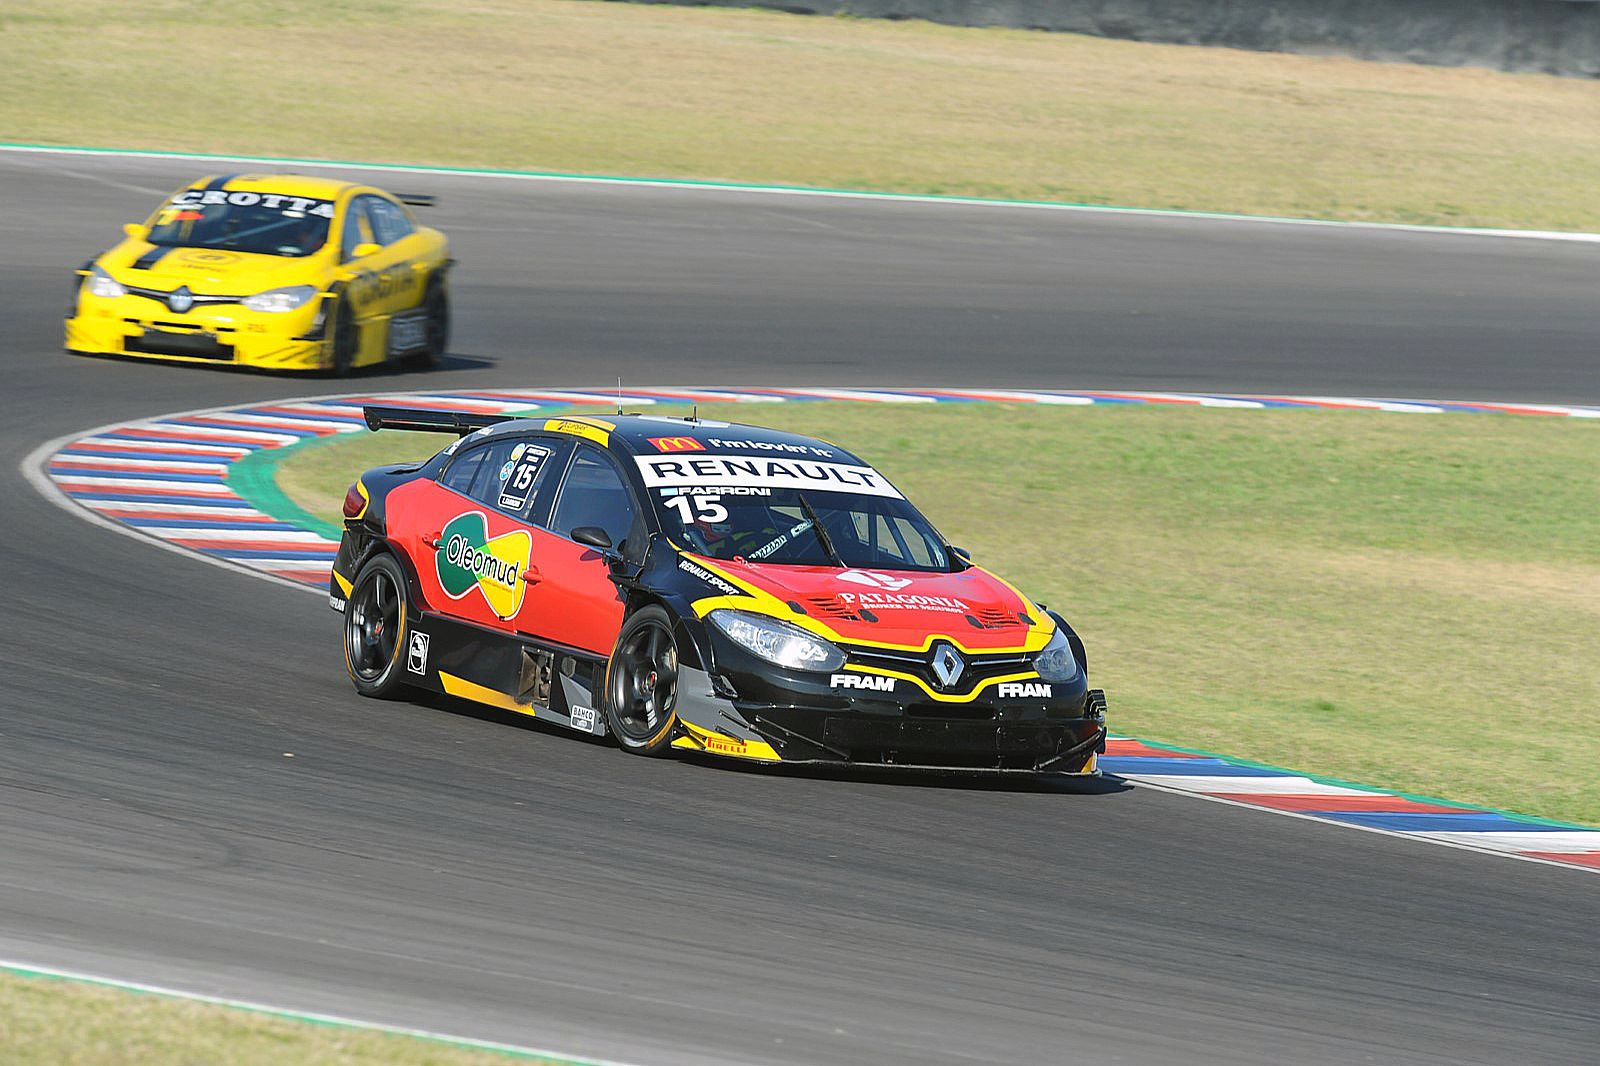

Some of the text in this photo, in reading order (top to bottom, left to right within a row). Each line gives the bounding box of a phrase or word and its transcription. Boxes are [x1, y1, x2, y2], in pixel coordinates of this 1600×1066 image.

[512, 463, 537, 490] 15
[650, 459, 876, 488] RENAULT
[679, 487, 772, 496] FARRONI
[663, 495, 729, 524] 15
[447, 535, 520, 588] Oleomud
[679, 560, 740, 595] RENAULT SPORT
[838, 593, 970, 610] PATAGONIA
[830, 674, 896, 692] FRAM
[998, 683, 1052, 698] FRAM
[708, 736, 747, 754] PIRELLI
